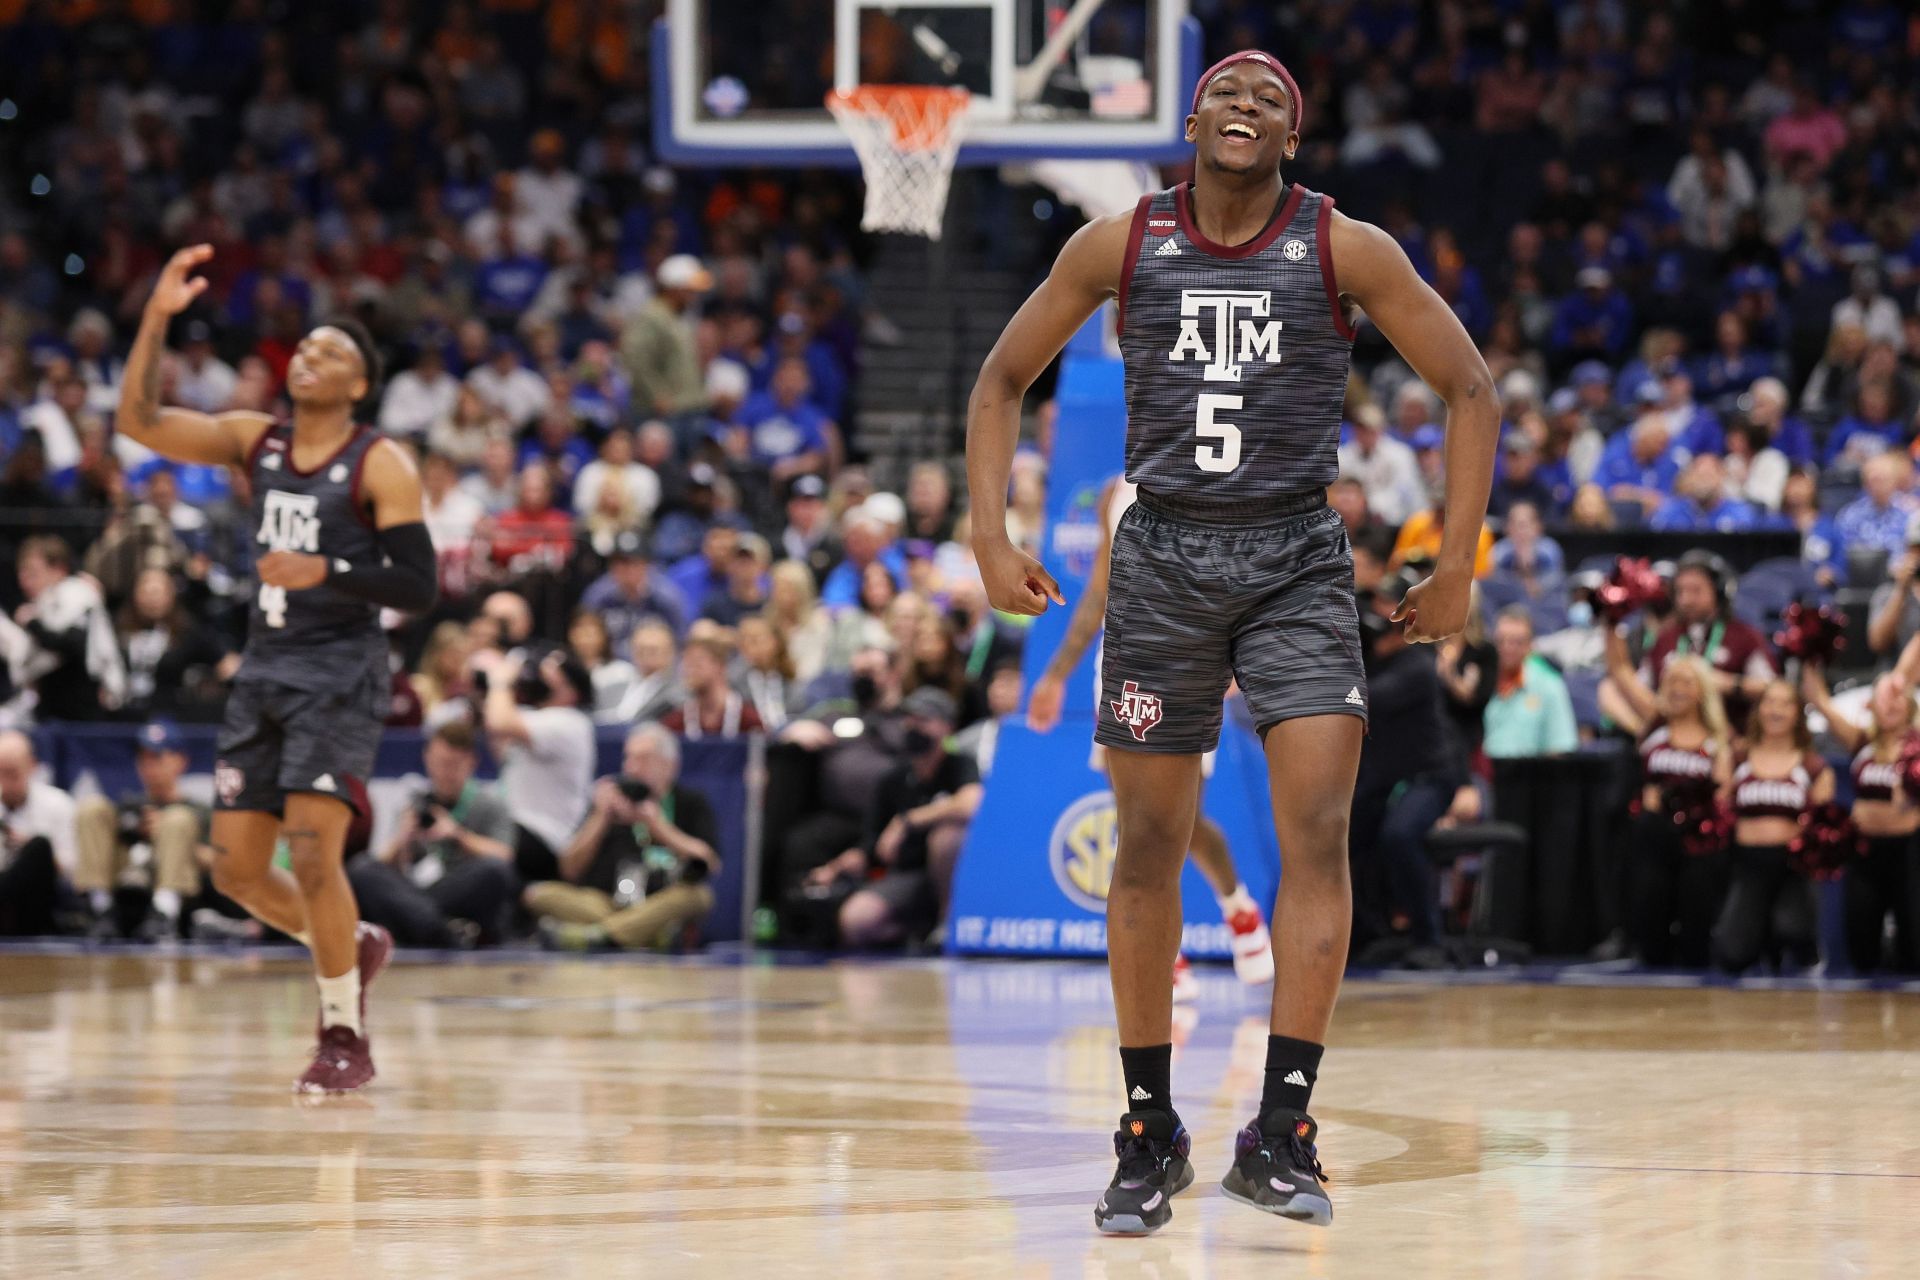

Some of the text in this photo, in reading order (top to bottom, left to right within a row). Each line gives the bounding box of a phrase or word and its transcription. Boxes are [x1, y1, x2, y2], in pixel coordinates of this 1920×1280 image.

[1155, 248, 1182, 256] adidas
[1286, 241, 1305, 259] SEC
[1195, 393, 1243, 472] 5
[259, 583, 288, 628] 4
[957, 916, 984, 946] IT
[988, 917, 1056, 948] JUST
